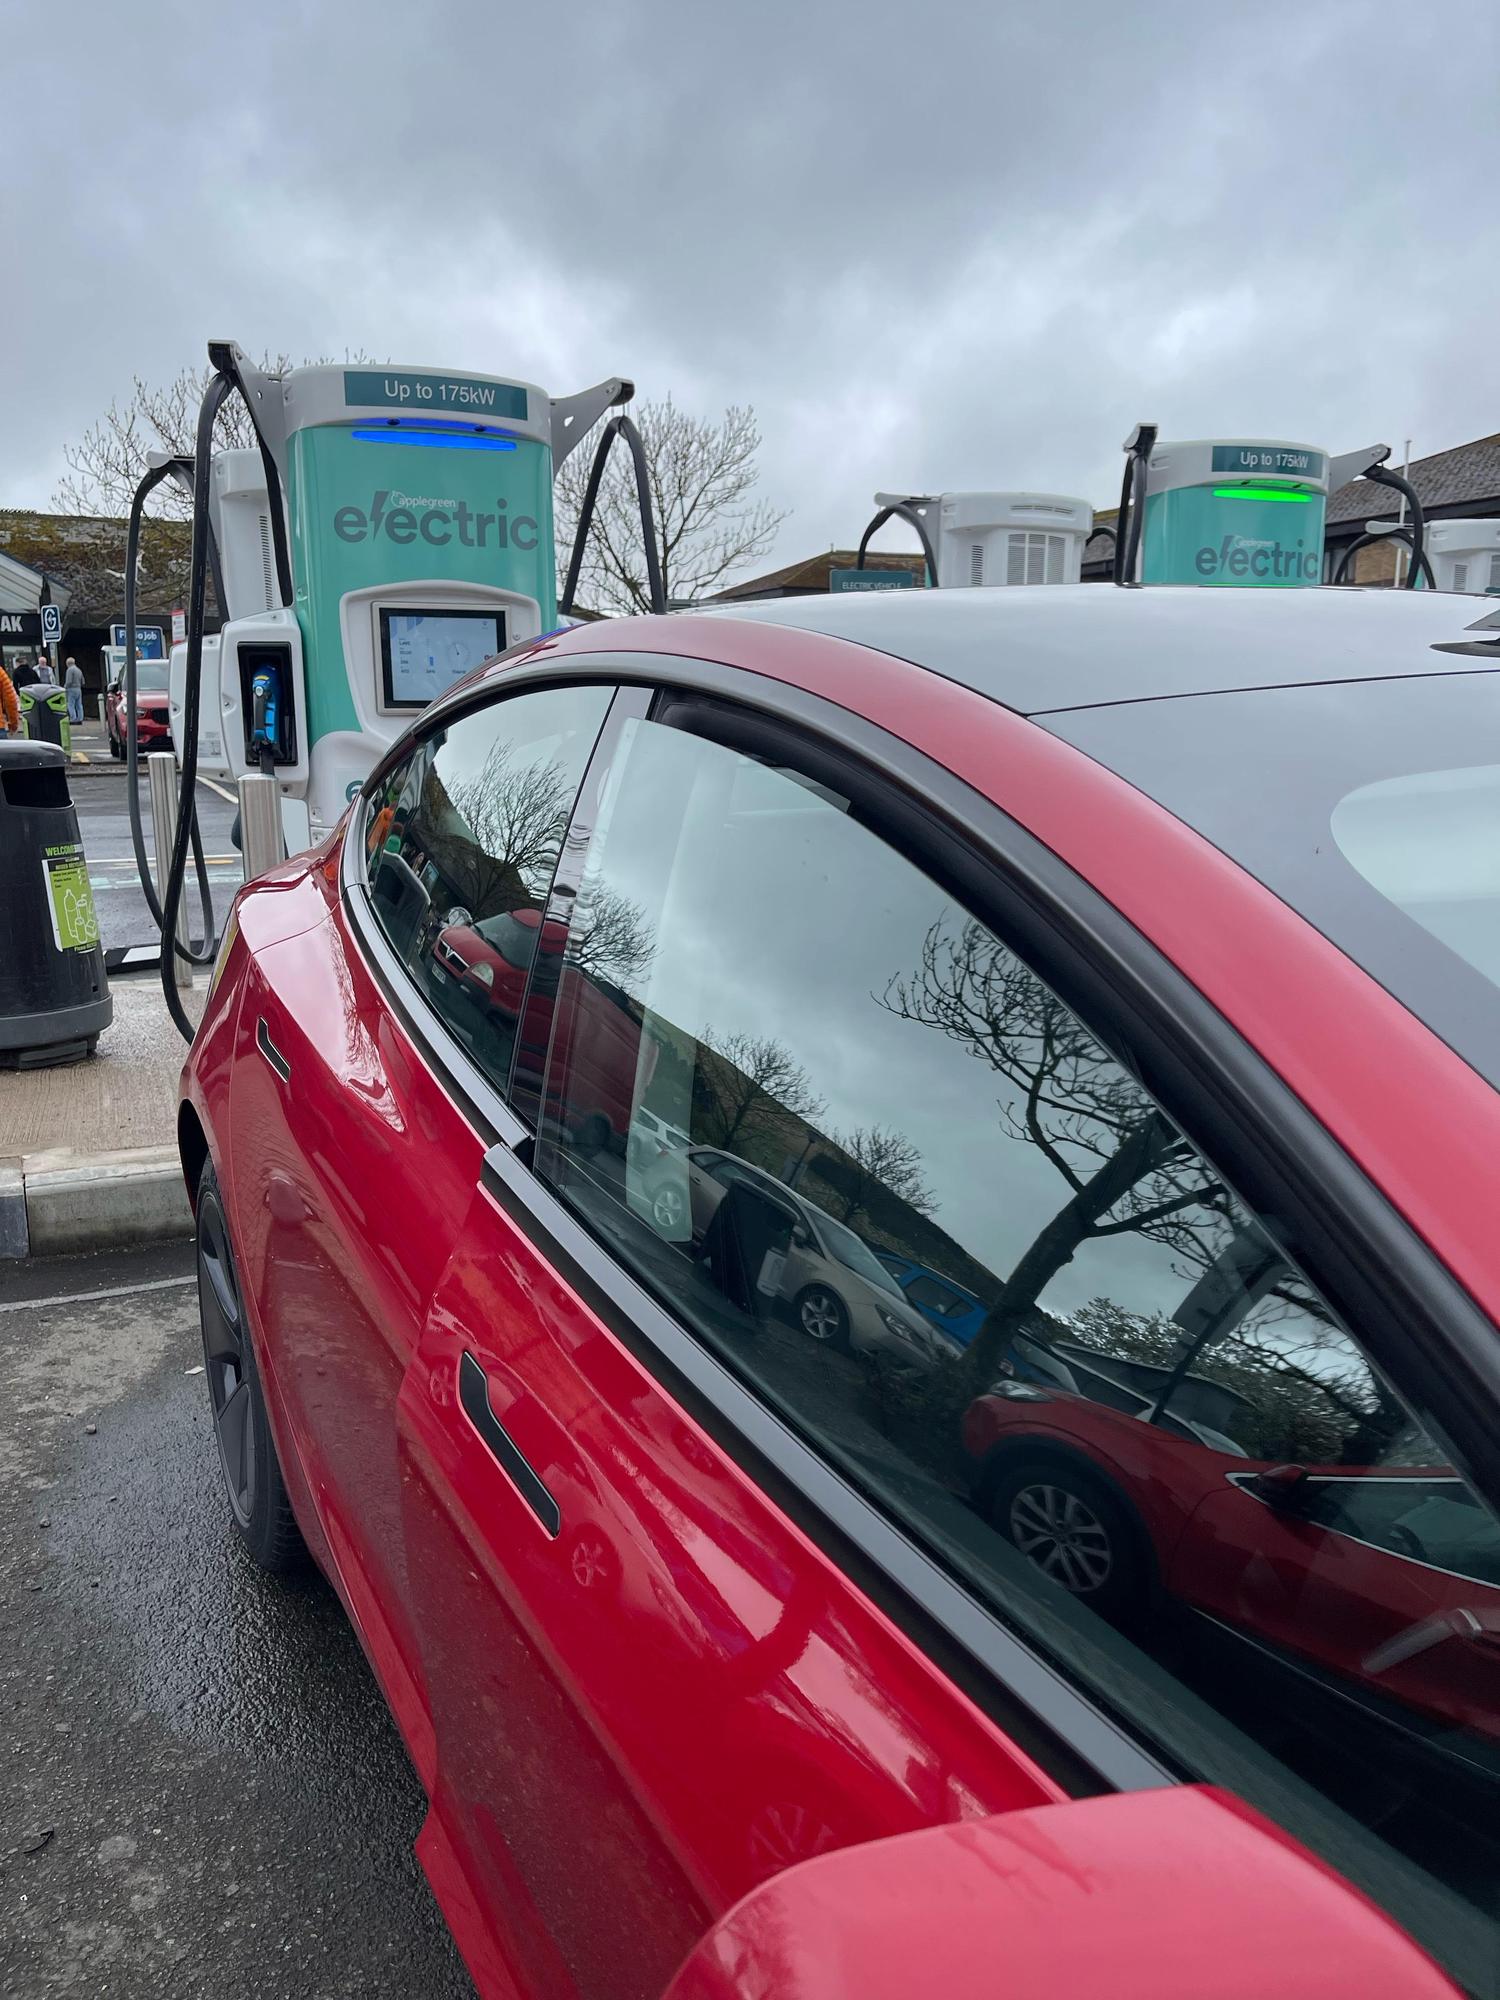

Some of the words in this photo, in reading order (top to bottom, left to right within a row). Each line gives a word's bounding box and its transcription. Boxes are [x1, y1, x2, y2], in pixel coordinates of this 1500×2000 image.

[384, 379, 410, 401] Up
[415, 382, 433, 399] to
[439, 384, 495, 405] 175kW
[1240, 452, 1259, 468] Up
[1261, 453, 1272, 466] to
[1276, 454, 1309, 468] 175kW
[398, 495, 456, 510] applegreen
[842, 581, 874, 590] ELECTRIC
[144, 631, 157, 641] job
